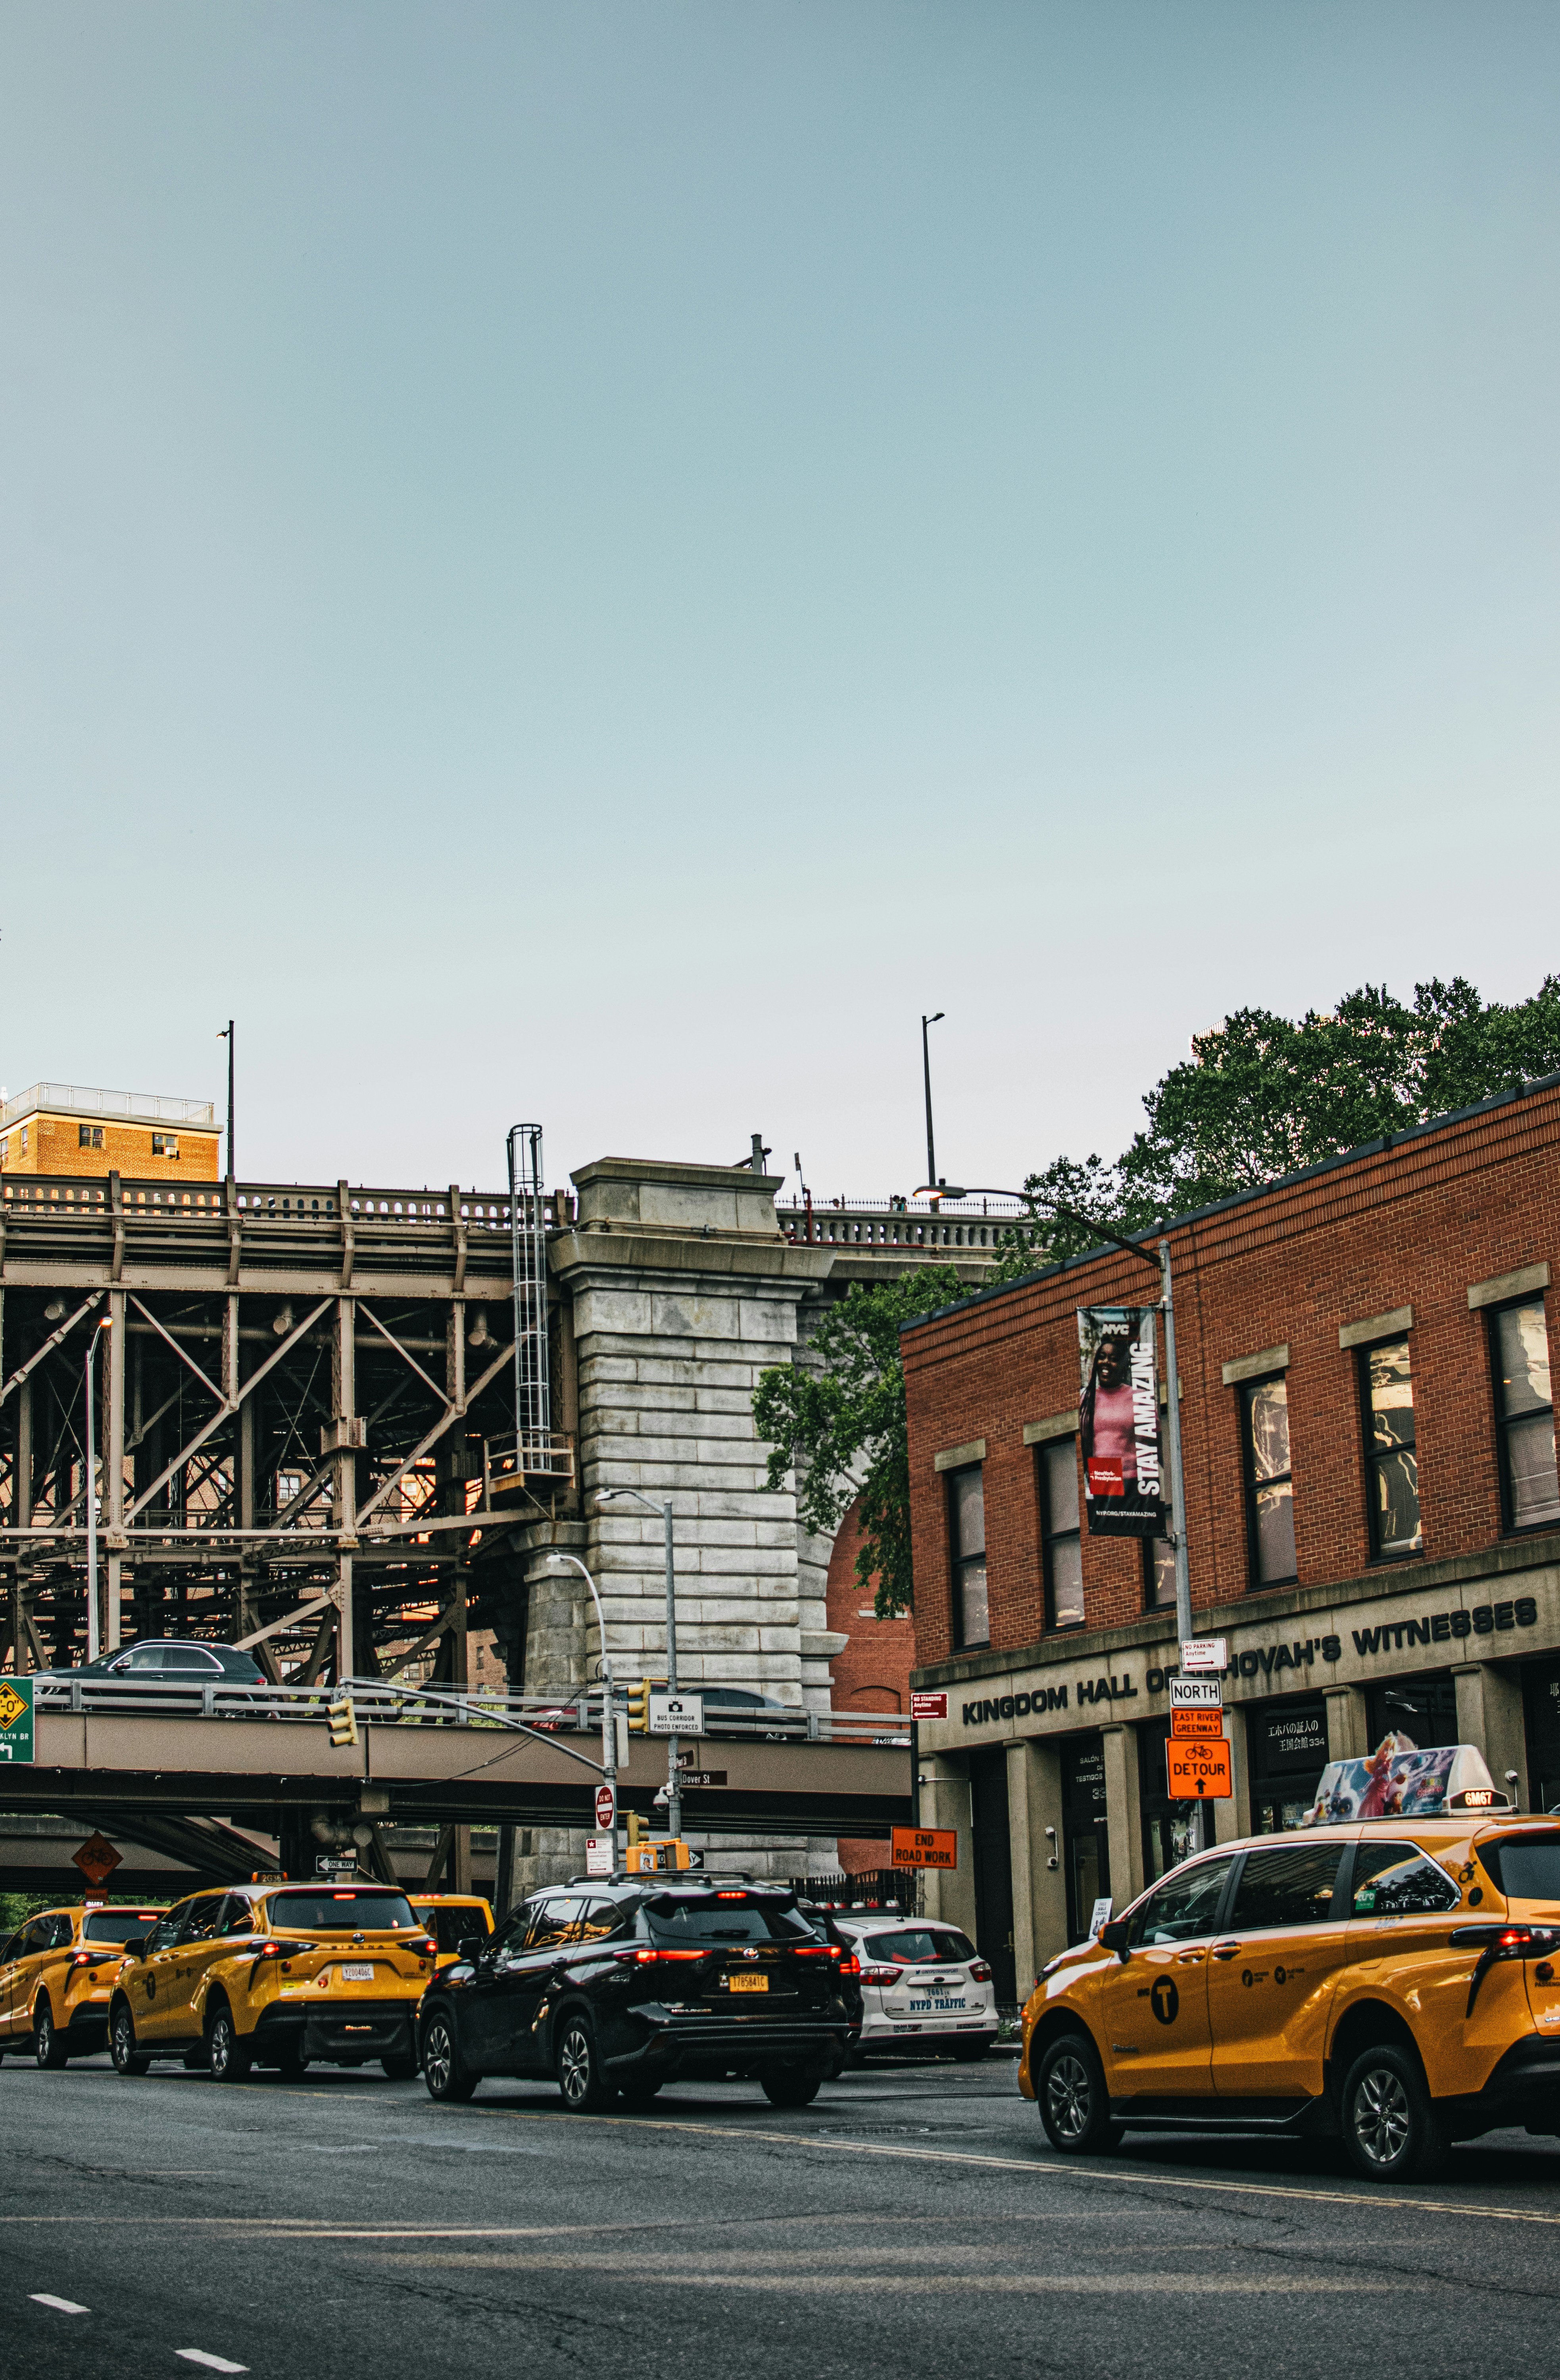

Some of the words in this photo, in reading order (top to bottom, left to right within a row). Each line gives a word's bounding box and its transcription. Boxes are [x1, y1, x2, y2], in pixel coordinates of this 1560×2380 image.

[1102, 1324, 1130, 1335] NYC
[1130, 1342, 1157, 1439] AMAZING
[1135, 1441, 1160, 1496] STAY
[963, 1685, 1068, 1725] KINGDOM
[1077, 1673, 1138, 1705] HALL
[1146, 1665, 1178, 1693] OF
[1351, 1597, 1537, 1655] WITNESSES
[1174, 1685, 1218, 1698] NORTH
[1174, 1713, 1194, 1721] EAST
[1176, 1724, 1218, 1733] GREENWAY
[1268, 1720, 1318, 1737] エホバの証人の
[1080, 1755, 1099, 1764] SALÓN
[1174, 1763, 1226, 1775] DETOUR
[683, 1774, 701, 1784] Dover
[703, 1774, 710, 1784] St
[1075, 1773, 1103, 1782] TESTIGOS
[1465, 1792, 1492, 1806] 6M67
[600, 1813, 610, 1821] ENTER
[915, 1833, 934, 1846] END
[895, 1848, 922, 1862] ROAD
[924, 1850, 951, 1864] WORK
[927, 1987, 943, 1996] 7661
[910, 2000, 932, 2011] NYPD
[935, 1998, 966, 2009] TRAFFIC
